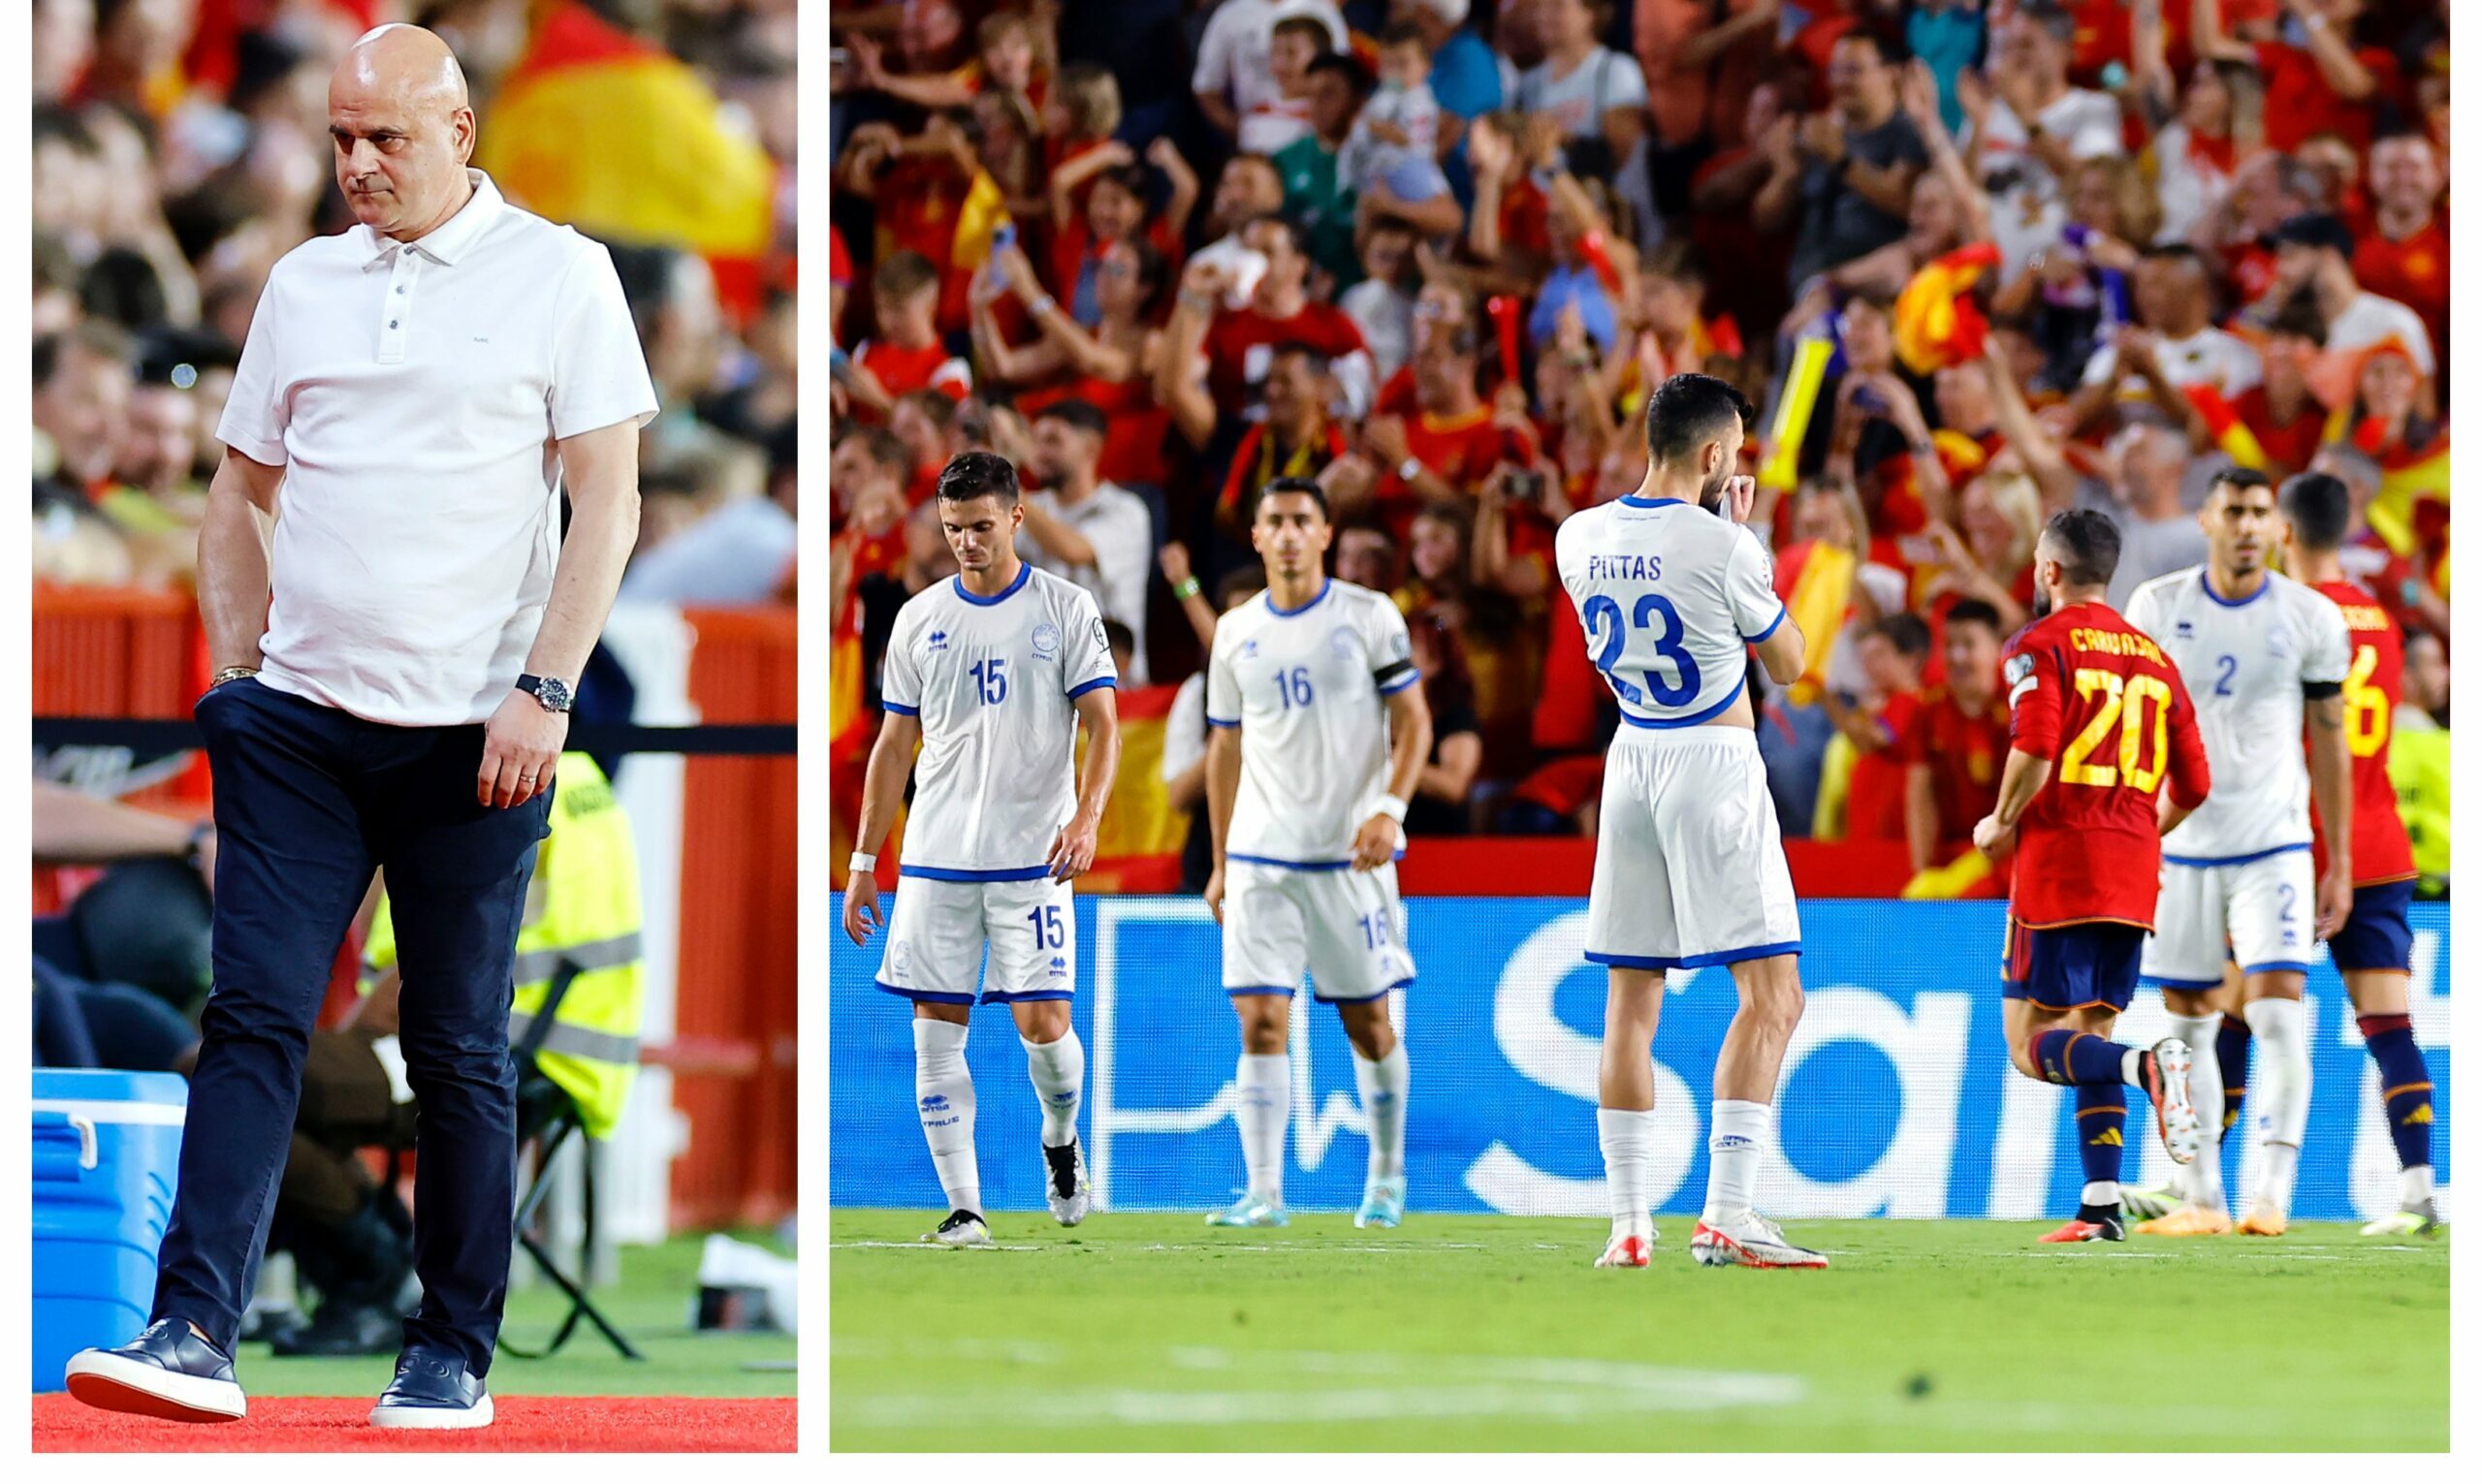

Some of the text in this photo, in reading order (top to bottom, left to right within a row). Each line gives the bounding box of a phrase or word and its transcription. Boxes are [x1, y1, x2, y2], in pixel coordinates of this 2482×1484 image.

[1589, 555, 1662, 581] PITTAS
[1583, 593, 1701, 708] 23
[970, 659, 1006, 706] 15
[1272, 667, 1312, 710] 16
[2214, 655, 2237, 696] 2
[2058, 667, 2172, 795] 20
[2278, 883, 2298, 922] 2
[1028, 905, 1065, 950] 15
